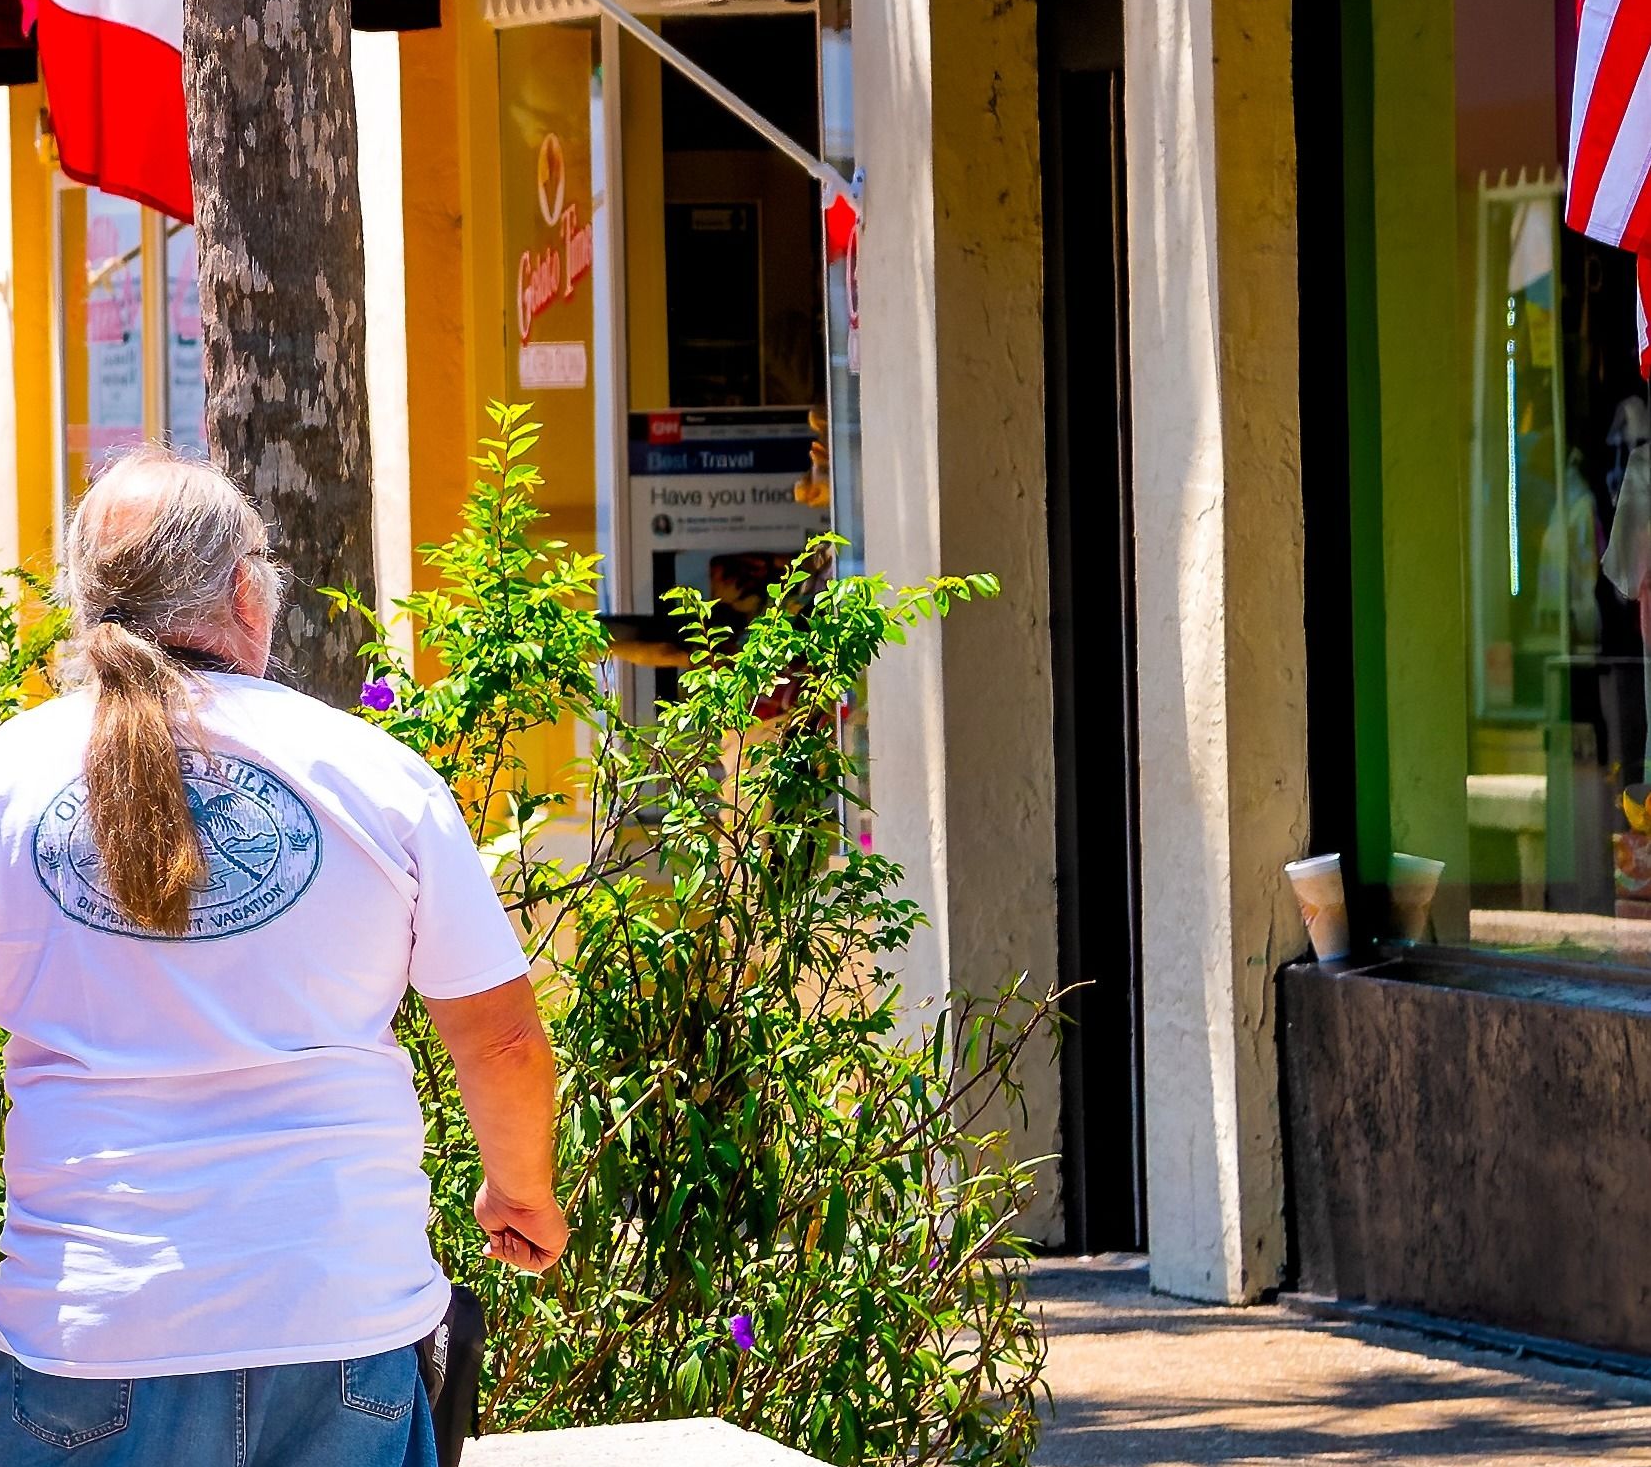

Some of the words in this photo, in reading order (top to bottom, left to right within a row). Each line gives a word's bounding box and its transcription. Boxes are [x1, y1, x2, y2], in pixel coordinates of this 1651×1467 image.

[698, 450, 755, 469] Travel
[650, 486, 703, 506] Have
[707, 487, 746, 509] you
[209, 883, 286, 929] VACATION
